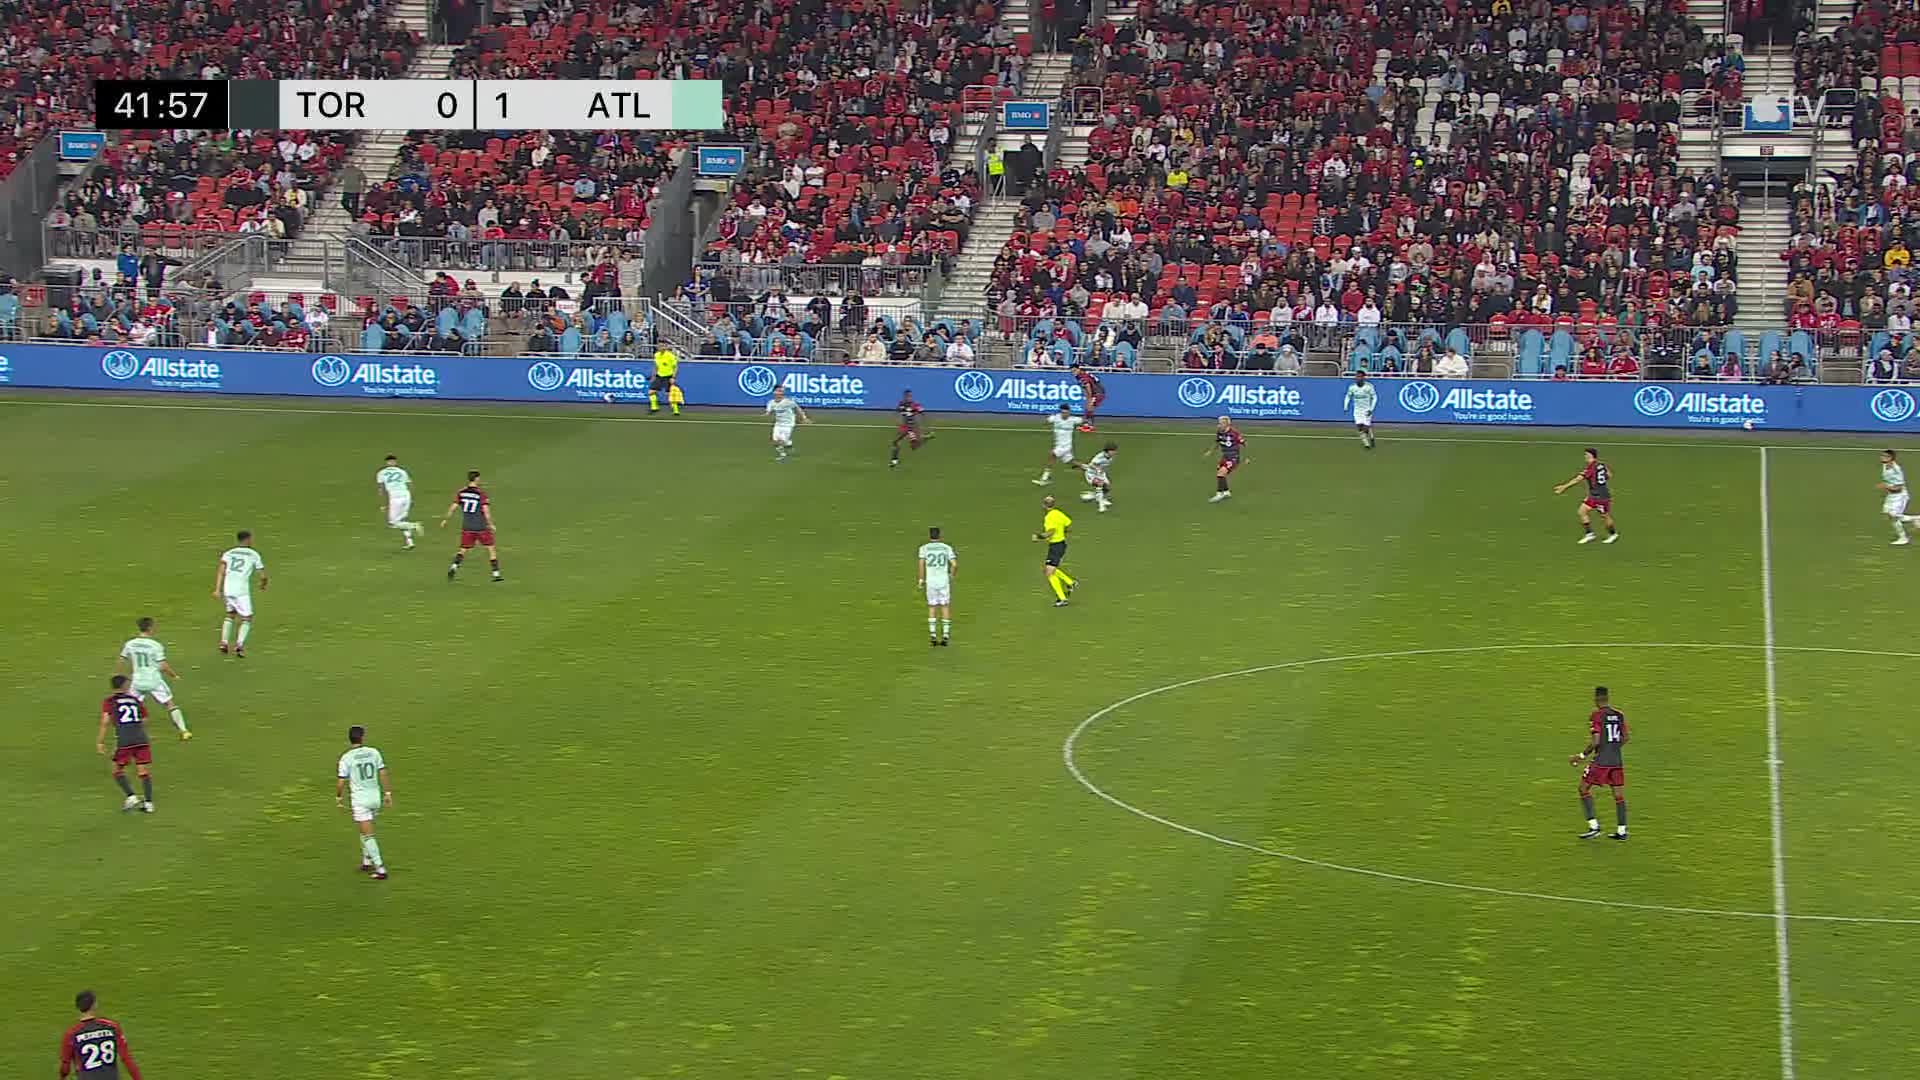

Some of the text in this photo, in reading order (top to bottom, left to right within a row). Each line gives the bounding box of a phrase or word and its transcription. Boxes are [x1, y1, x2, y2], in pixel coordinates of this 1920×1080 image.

[140, 357, 219, 378] Allstate
[351, 363, 436, 385] Allstate
[565, 368, 646, 389] Allstate
[782, 373, 864, 394] Allstate
[994, 378, 1083, 400] Allstate
[1216, 384, 1300, 405] Allstate
[1441, 388, 1532, 410] Allstate
[1675, 392, 1765, 414] Allstate
[383, 471, 401, 483] 22
[1597, 469, 1606, 484] 5
[461, 499, 479, 513] 77
[230, 556, 245, 572] 12
[927, 552, 946, 567] 20
[133, 651, 149, 667] 11
[118, 705, 140, 722] 21
[1605, 724, 1620, 741] 14
[355, 762, 375, 780] 10
[81, 1040, 115, 1070] 28
